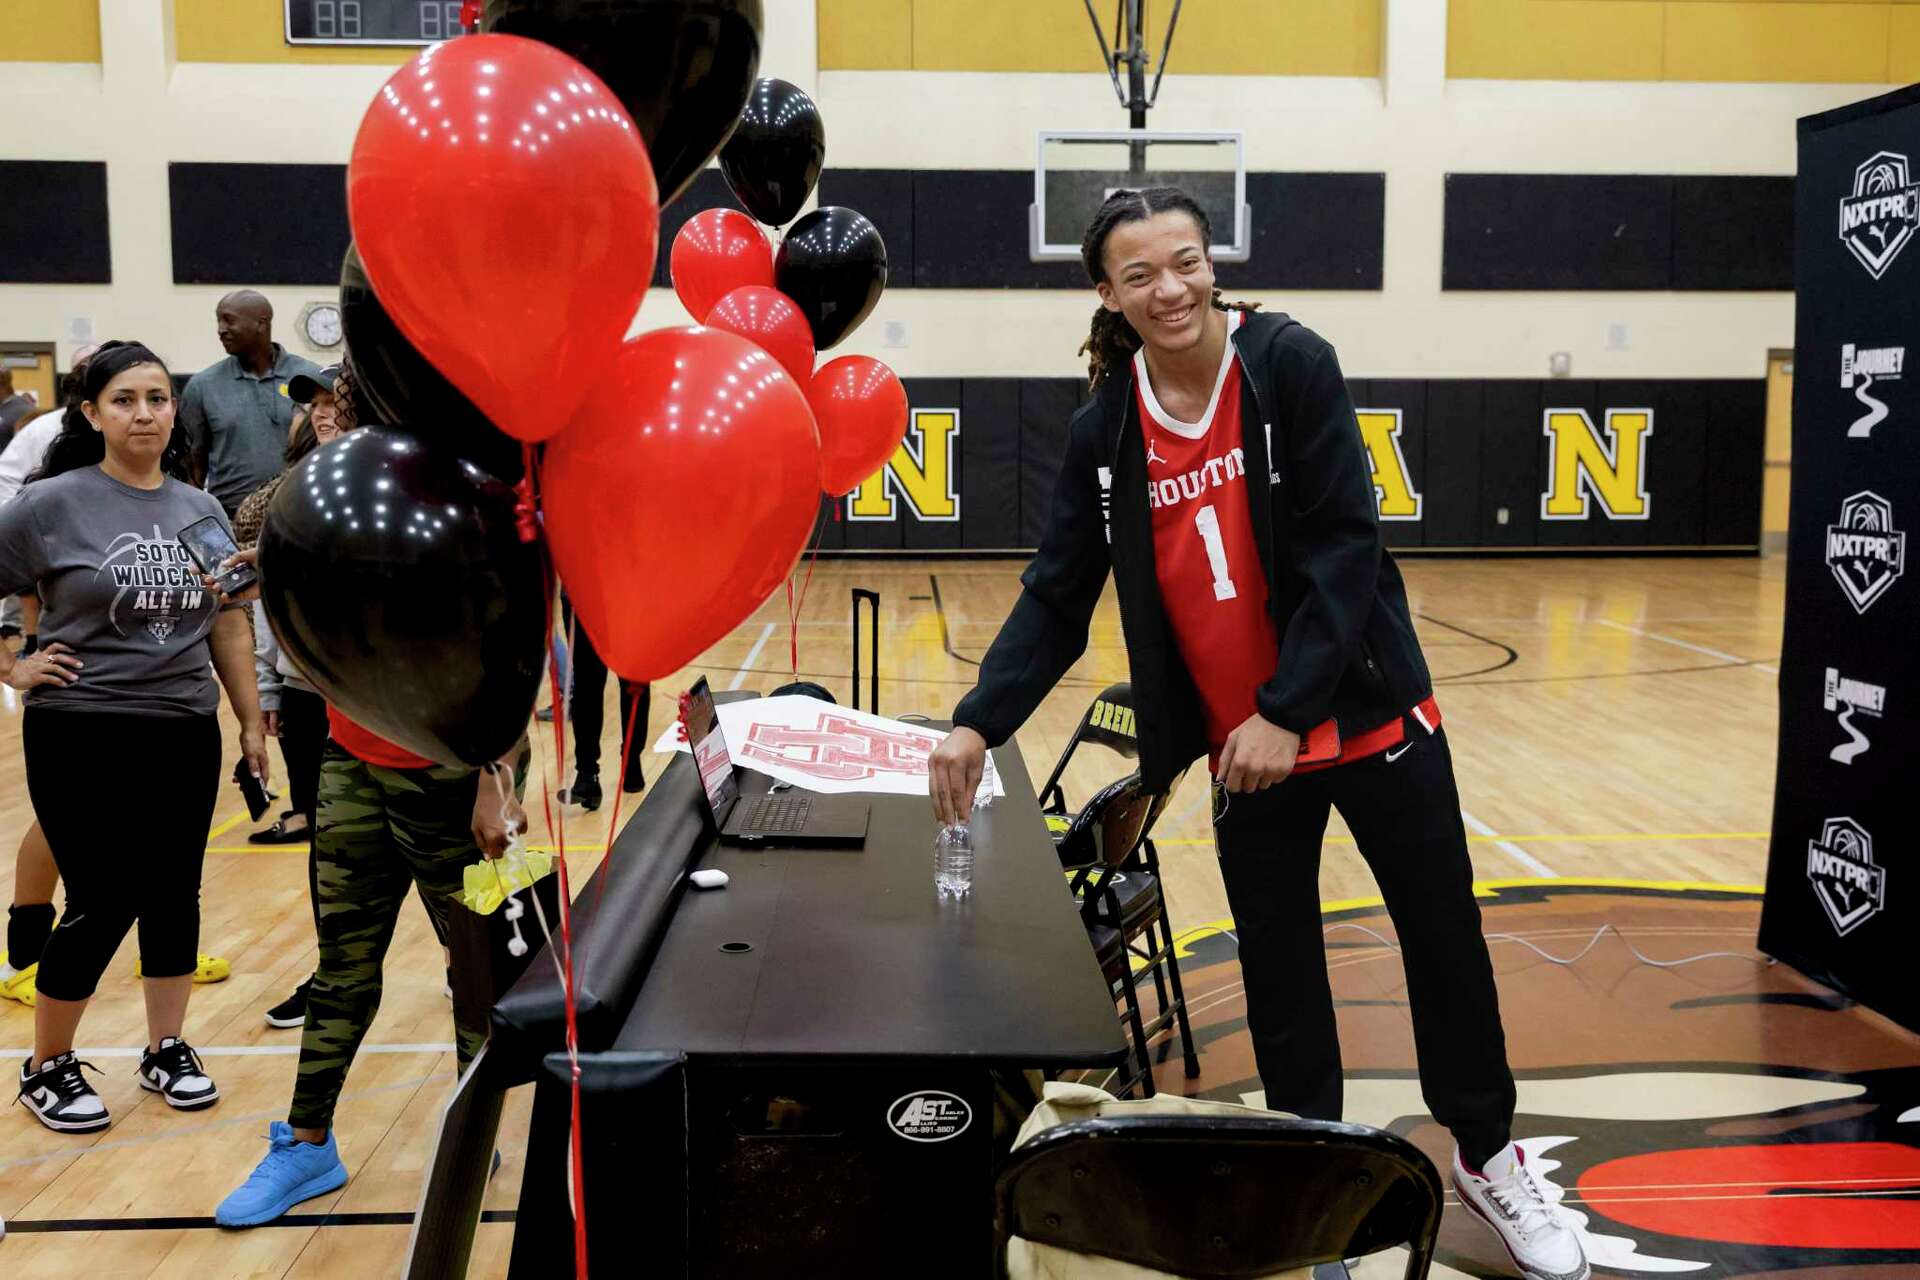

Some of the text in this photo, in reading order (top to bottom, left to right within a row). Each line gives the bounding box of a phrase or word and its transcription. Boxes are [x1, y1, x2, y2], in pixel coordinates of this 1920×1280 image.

[1194, 504, 1238, 601] 1
[112, 566, 206, 587] WILDCA
[133, 590, 203, 609] ALL IN
